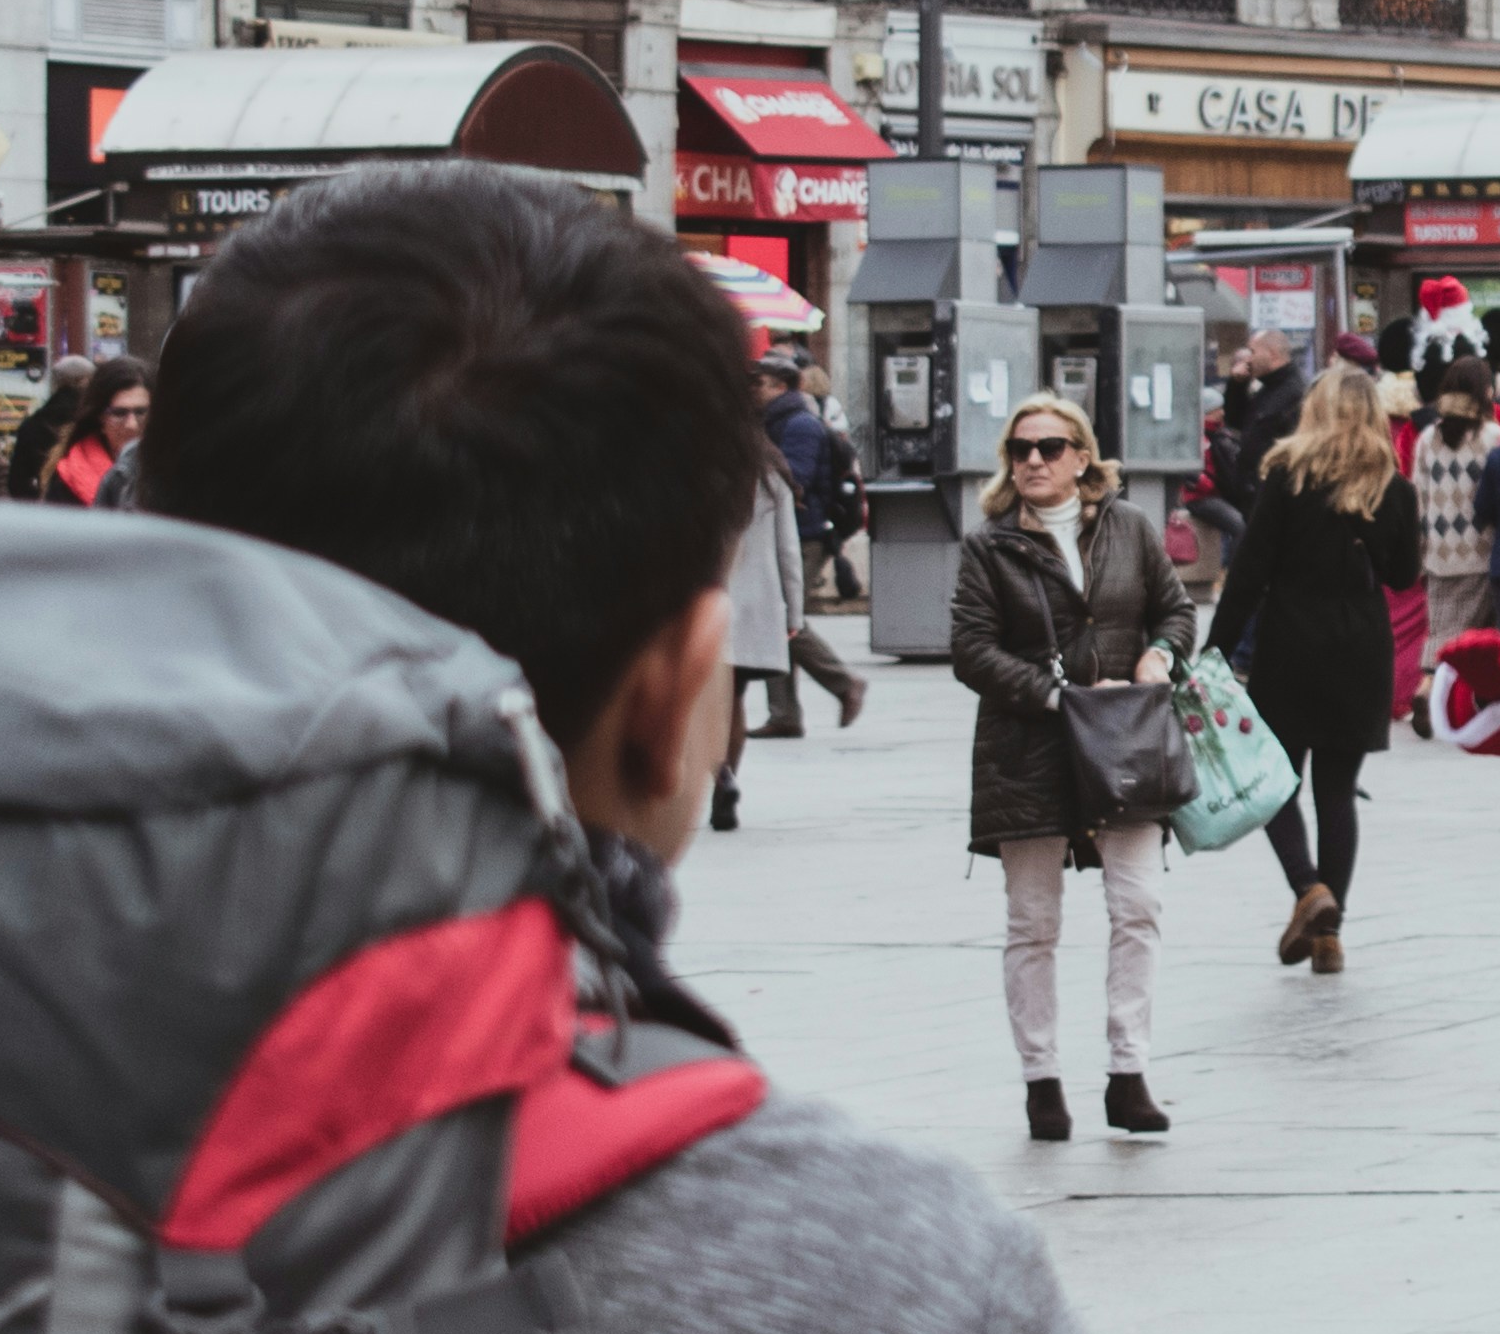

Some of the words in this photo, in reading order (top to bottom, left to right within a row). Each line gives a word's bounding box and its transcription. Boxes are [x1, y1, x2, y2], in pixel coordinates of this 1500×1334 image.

[992, 65, 1038, 103] SOL
[1198, 85, 1305, 134] CASA
[197, 188, 271, 215] TOURS
